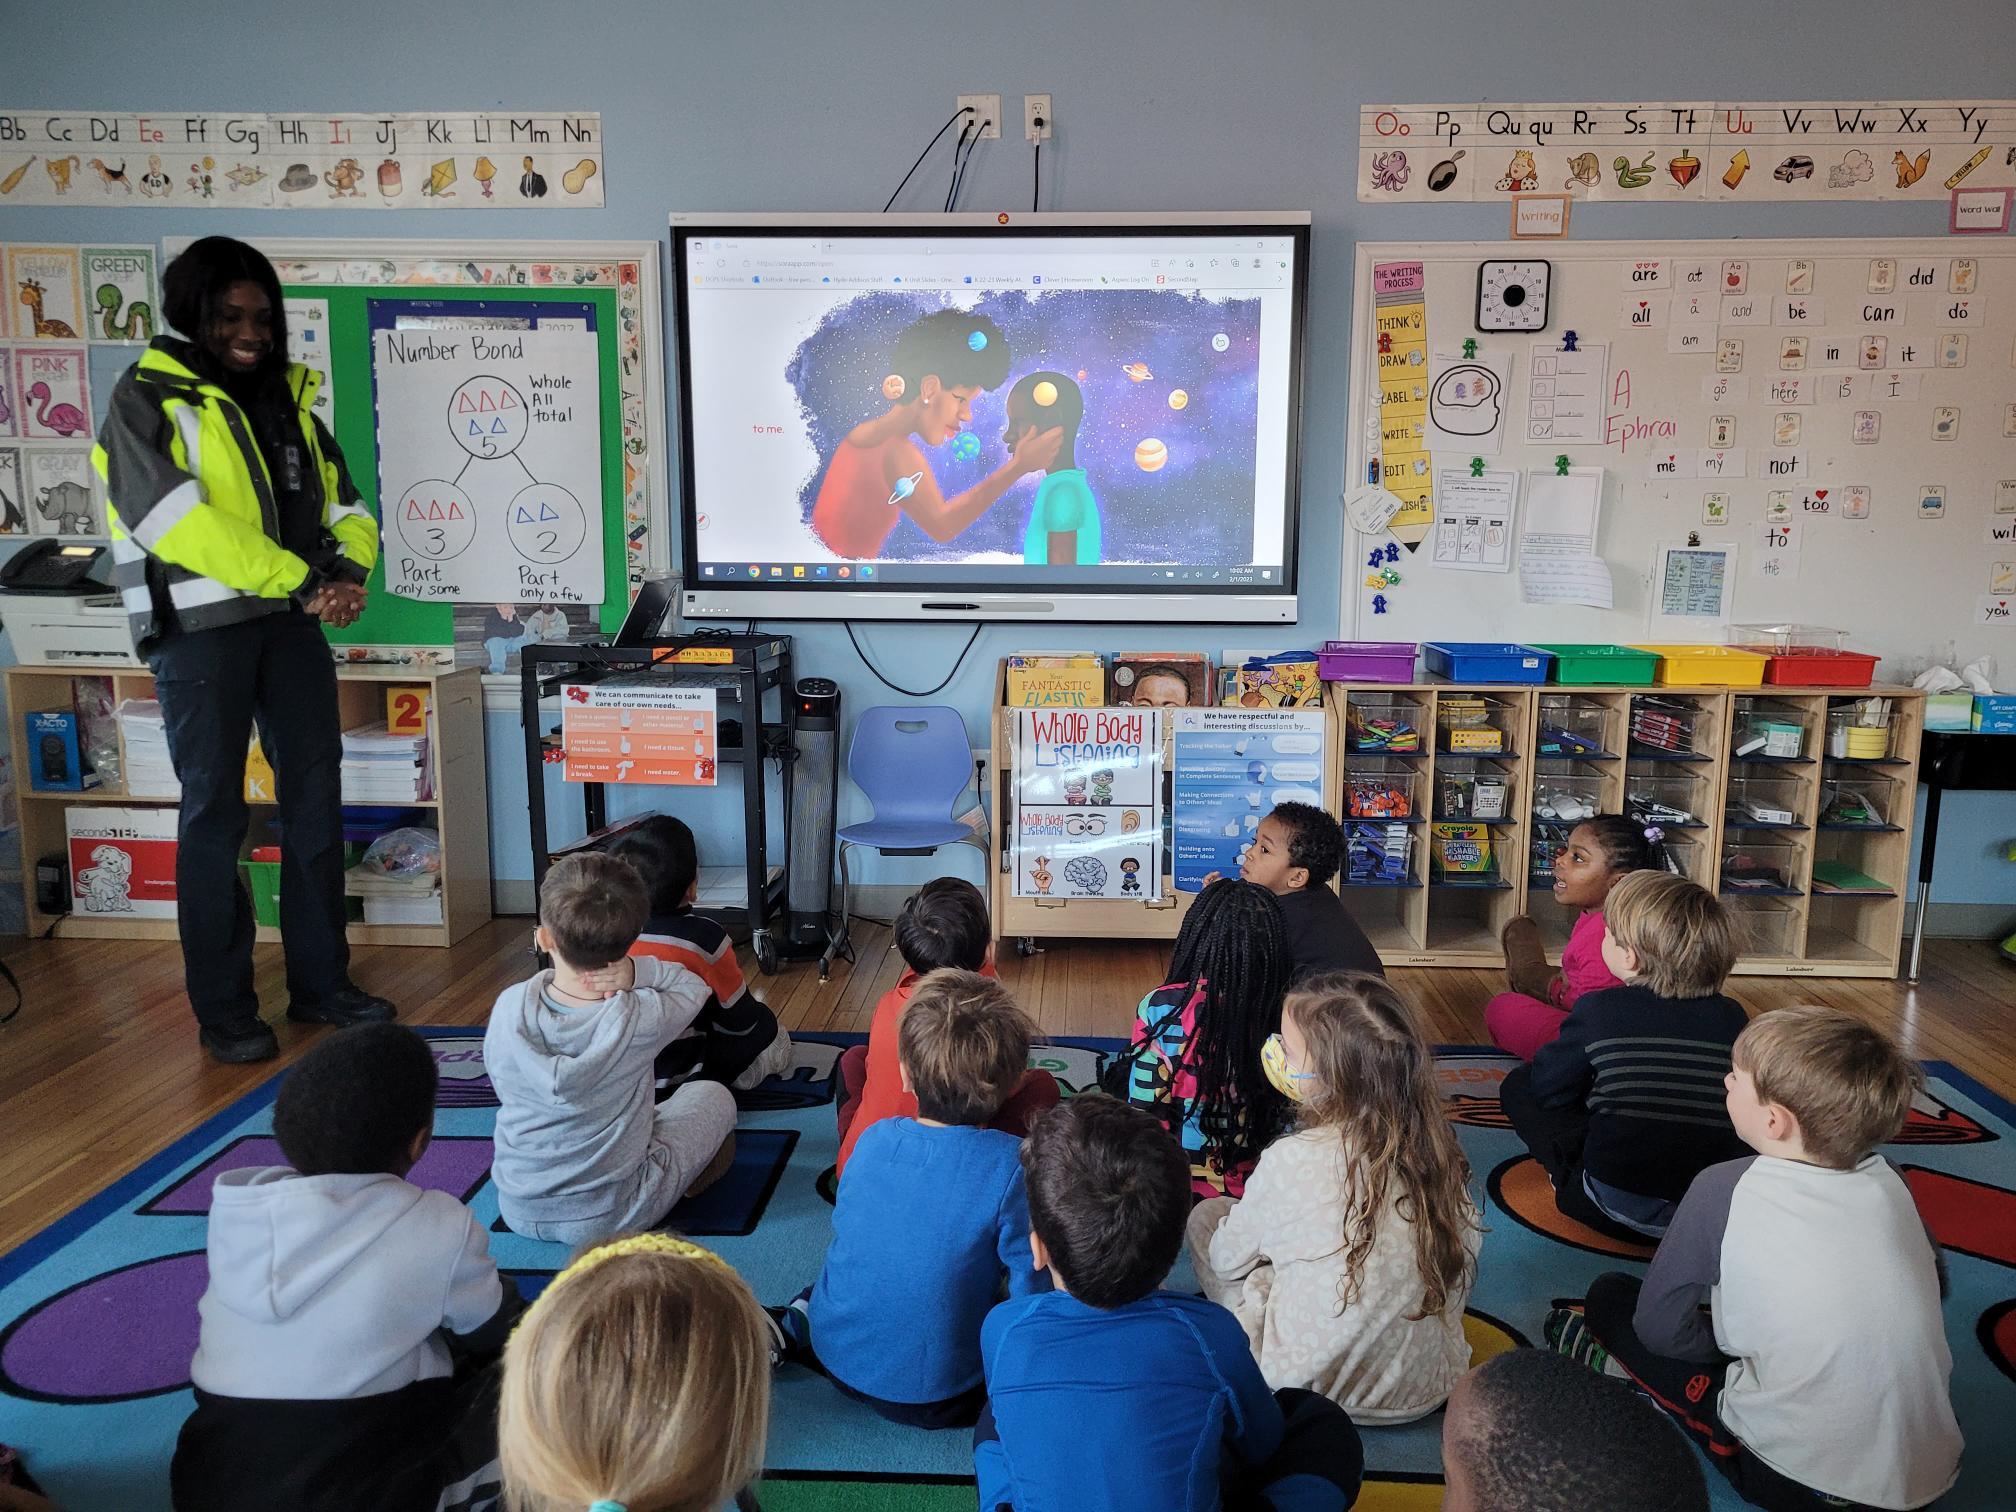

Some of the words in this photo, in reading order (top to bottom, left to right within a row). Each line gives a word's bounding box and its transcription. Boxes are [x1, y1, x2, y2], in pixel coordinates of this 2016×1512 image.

[1375, 112, 1410, 136] Oo
[1435, 112, 1460, 147] Pp
[1487, 111, 1520, 135] Qu
[1529, 121, 1552, 145] qu
[1573, 111, 1597, 134] Rr
[1624, 110, 1647, 134] Ss
[1671, 110, 1696, 134] Tt
[1726, 110, 1752, 133] Uu
[1783, 109, 1812, 132] Vv
[1835, 109, 1876, 132] Ww
[1897, 108, 1927, 132] Xx
[1958, 108, 1988, 143] Yy
[0, 117, 26, 141] Bb
[46, 118, 73, 141] Cc
[90, 118, 119, 142] Dd
[139, 119, 164, 142] Ee
[185, 119, 207, 142] Ff
[225, 120, 260, 154] Gg
[280, 121, 308, 144] Hh
[376, 120, 397, 154] Jj
[427, 120, 452, 143] Kk
[474, 120, 491, 143] Ll
[511, 120, 549, 143] Mm
[563, 119, 591, 142] Nn
[1955, 162, 1974, 179] YELLOW
[1960, 205, 1981, 214] Word
[1521, 211, 1560, 224] Writing
[91, 257, 145, 273] GREEN
[1730, 262, 1742, 271] Aa
[1796, 262, 1807, 270] Bb
[1877, 261, 1889, 269] Cc
[1958, 260, 1970, 269] Dd
[1374, 269, 1387, 280] THE
[1389, 266, 1423, 279] WRITING
[1632, 270, 1659, 282] are
[1687, 267, 1703, 282] at
[1909, 267, 1935, 286] did
[1384, 278, 1414, 288] PROCESS
[1632, 308, 1651, 323] all
[1690, 305, 1700, 314] a
[1731, 302, 1753, 318] and
[1788, 303, 1807, 320] be
[1949, 303, 1968, 319] do
[1378, 315, 1410, 329] THINK
[387, 333, 461, 364] Number
[472, 336, 524, 360] Bond
[1682, 336, 1699, 346] am
[1725, 341, 1736, 350] Gg
[1789, 338, 1801, 346] Hh
[1826, 345, 1839, 360] in
[1902, 346, 1916, 362] it
[32, 357, 69, 372] PINK
[1380, 354, 1408, 367] DRAW
[528, 374, 573, 390] Whole
[1613, 369, 1631, 408] A
[1838, 381, 1852, 398] is
[1713, 385, 1727, 402] go
[1771, 383, 1799, 400] here
[1888, 382, 1901, 398] I
[532, 393, 553, 407] All
[1381, 392, 1409, 405] LABEL
[532, 407, 572, 422] total
[1783, 414, 1794, 422] Nn
[1941, 408, 1953, 417] Pp
[1715, 417, 1730, 425] Mm
[752, 425, 764, 434] to
[1383, 427, 1409, 441] WRITE
[482, 436, 497, 457] 5
[1384, 464, 1405, 477] EDIT
[1656, 461, 1676, 473] me
[1705, 459, 1724, 475] my
[1769, 455, 1800, 475] not
[1400, 500, 1420, 511] LISH
[1802, 496, 1829, 511] too
[425, 528, 446, 555] 3
[536, 531, 561, 554] 2
[1765, 528, 1788, 548] to
[400, 558, 442, 583] Part
[1762, 559, 1780, 576] the
[2000, 563, 2010, 572] Yy
[518, 565, 560, 586] Part
[394, 583, 422, 598] only
[429, 584, 461, 596] some
[520, 587, 545, 600] only
[560, 587, 583, 602] few
[1985, 607, 2011, 621] you
[1022, 681, 1091, 691] FANTASTIC
[595, 690, 607, 698] We
[623, 692, 673, 700] communicate
[394, 693, 423, 728] 2
[1218, 712, 1238, 720] have
[1239, 712, 1278, 721] respectful
[1279, 712, 1295, 720] and
[1031, 711, 1089, 744] Whole
[1096, 712, 1143, 745] Body
[1204, 723, 1247, 731] interesting
[1035, 743, 1140, 769] Listening
[249, 779, 268, 799] K
[1441, 824, 1475, 833] Crayola
